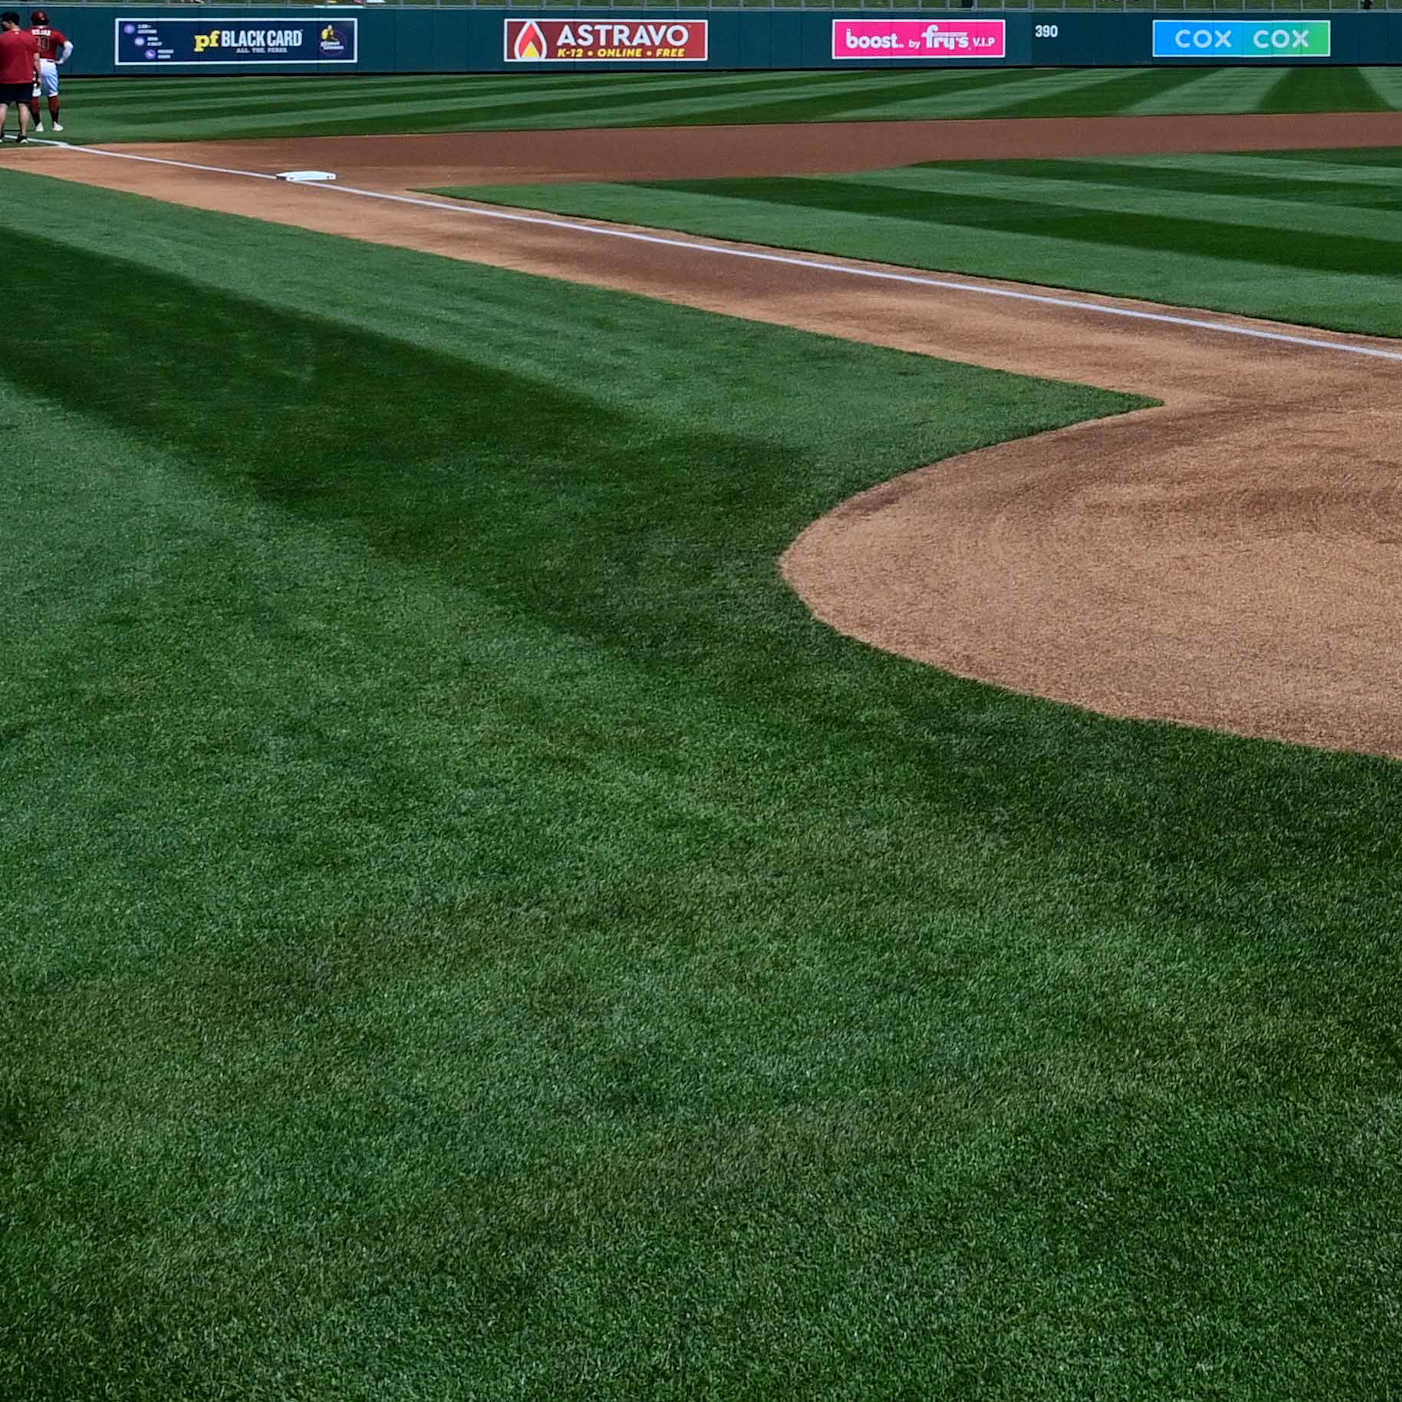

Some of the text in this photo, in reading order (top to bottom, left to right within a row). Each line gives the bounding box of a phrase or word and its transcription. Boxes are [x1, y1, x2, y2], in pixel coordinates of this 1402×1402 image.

[194, 30, 220, 52] pf
[221, 30, 266, 47] BLACK
[266, 30, 302, 47] CARD
[556, 24, 689, 46] ASTRAVO
[908, 39, 921, 49] by
[921, 24, 969, 50] fry's
[1035, 24, 1058, 38] 390
[1175, 29, 1309, 48] COX COX
[557, 48, 685, 57] K-12 ONLINE FREE
